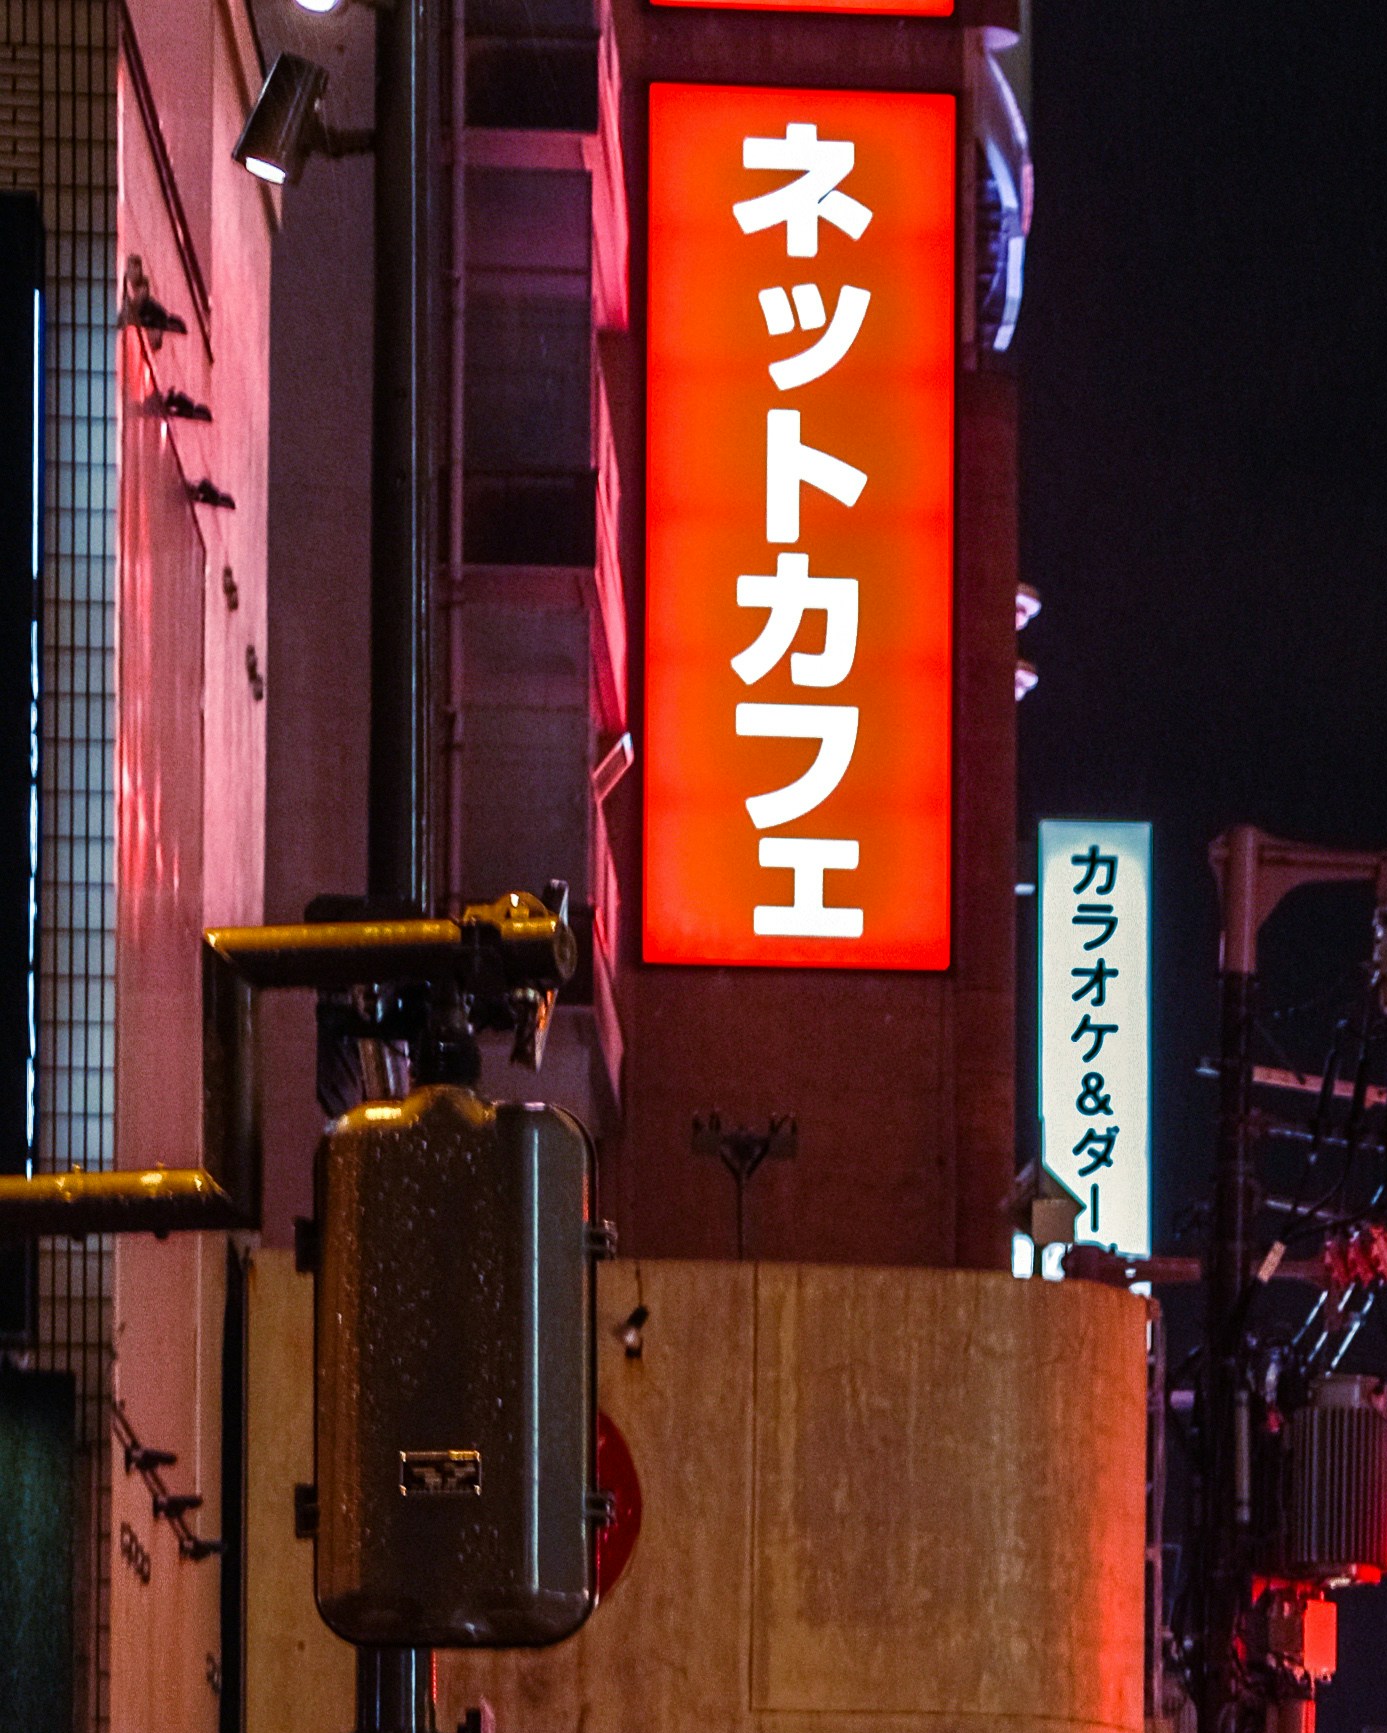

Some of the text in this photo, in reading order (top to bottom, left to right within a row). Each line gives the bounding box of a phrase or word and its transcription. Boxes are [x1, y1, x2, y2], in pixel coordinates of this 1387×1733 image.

[729, 122, 874, 939] ネットカフェ
[1071, 845, 1119, 1252] カラオケ&ダー
